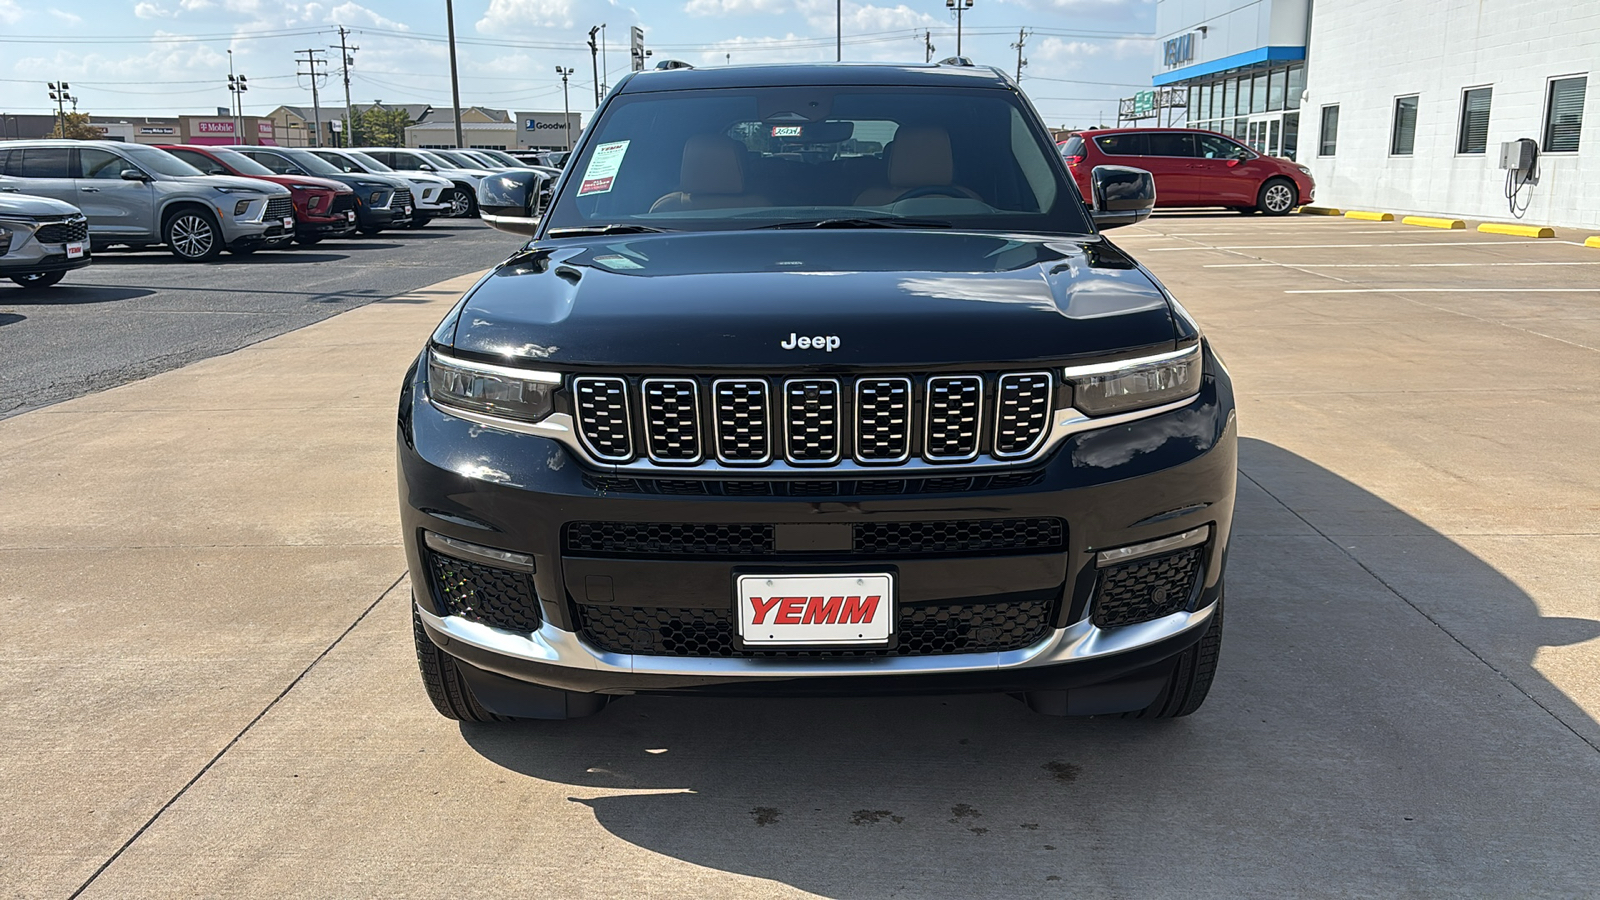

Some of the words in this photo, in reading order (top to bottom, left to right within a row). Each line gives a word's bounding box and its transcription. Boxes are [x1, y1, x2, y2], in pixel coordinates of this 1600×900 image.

[1163, 33, 1195, 66] YEMM
[780, 332, 841, 353] Jeep
[750, 595, 881, 625] YEMM
